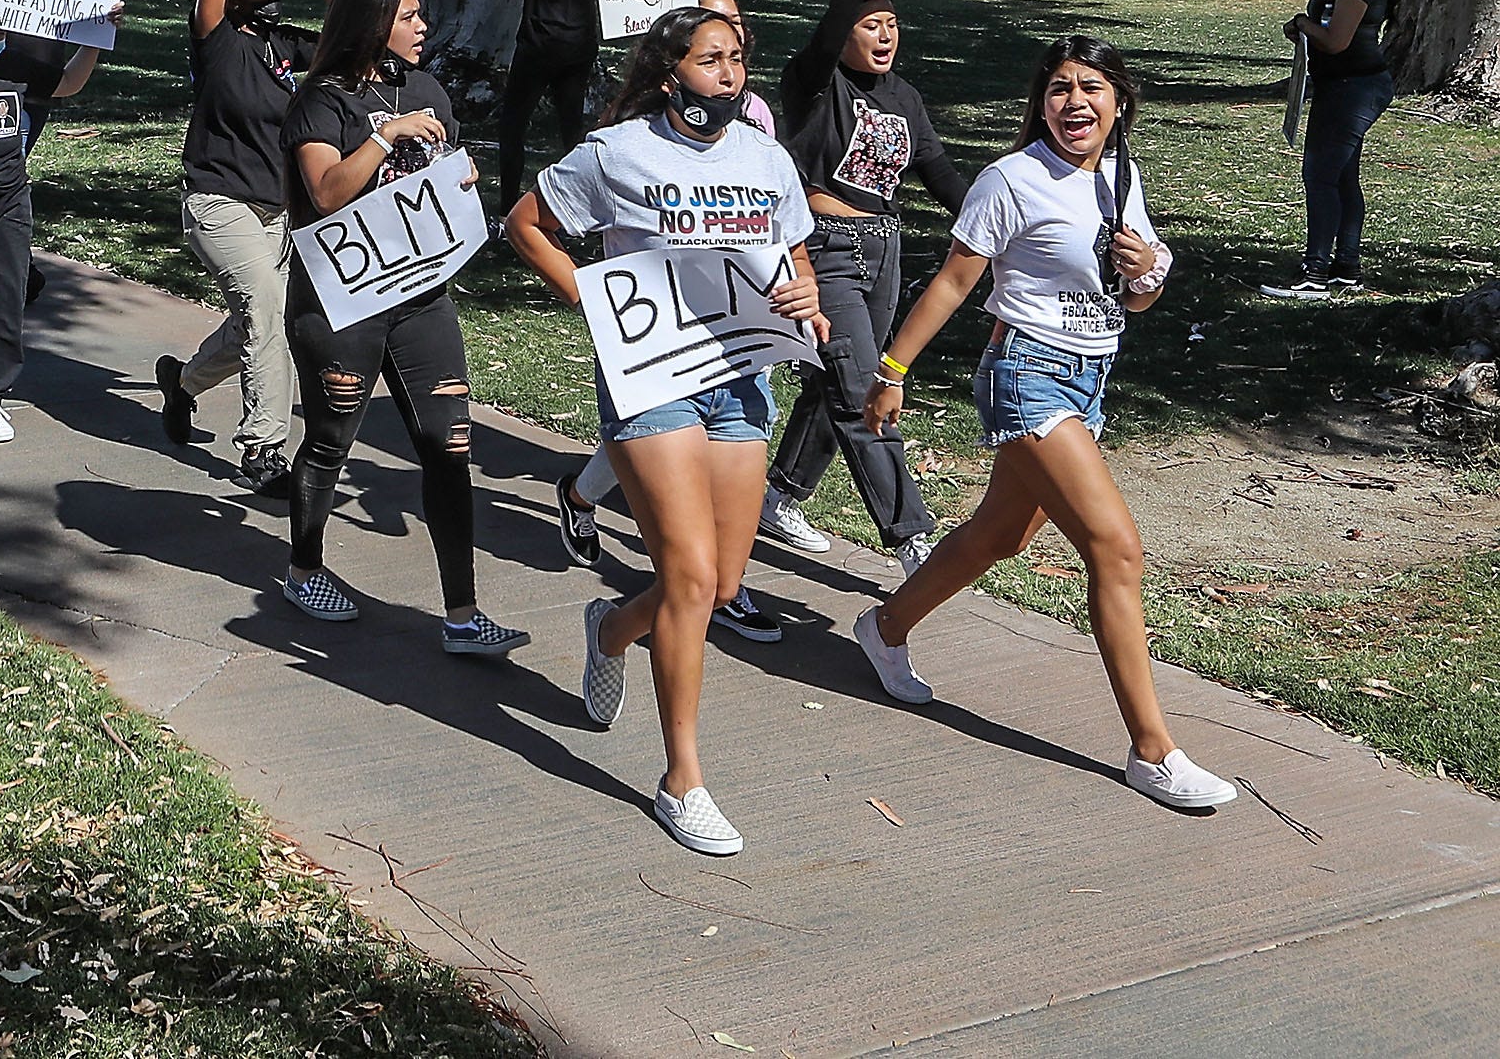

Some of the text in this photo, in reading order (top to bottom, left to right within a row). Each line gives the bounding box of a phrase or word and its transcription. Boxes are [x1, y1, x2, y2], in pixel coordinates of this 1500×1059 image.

[87, 2, 106, 25] AS
[36, 14, 73, 40] MAN!
[644, 183, 778, 208] NO JUSTICE
[314, 177, 455, 285] BLM
[659, 209, 696, 234] NO
[603, 253, 804, 343] BLM
